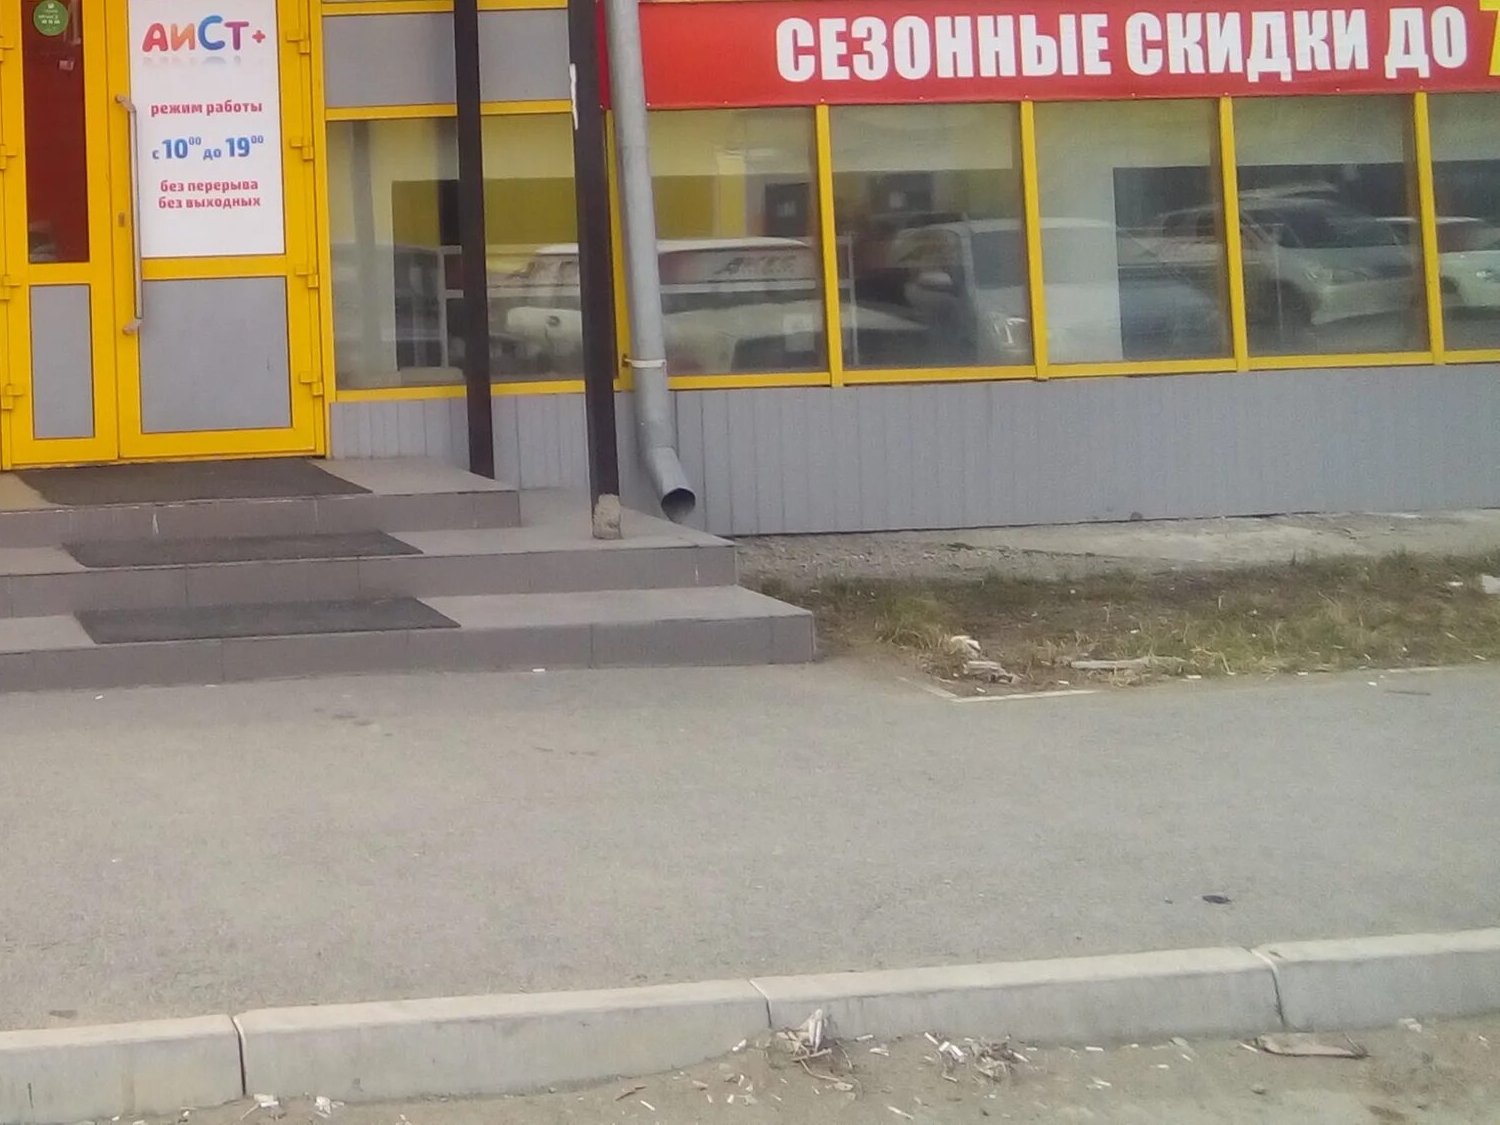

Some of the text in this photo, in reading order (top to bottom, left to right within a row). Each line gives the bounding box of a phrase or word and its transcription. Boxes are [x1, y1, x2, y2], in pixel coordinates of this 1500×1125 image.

[775, 14, 1112, 83] СЕЗОННЫЕ
[1125, 8, 1370, 83] СКИДКИ
[1384, 5, 1468, 79] ДО
[150, 99, 263, 118] режим работы
[151, 149, 160, 160] с
[202, 147, 222, 161] до
[160, 179, 259, 195] без перерыва
[158, 195, 261, 209] без выходных
